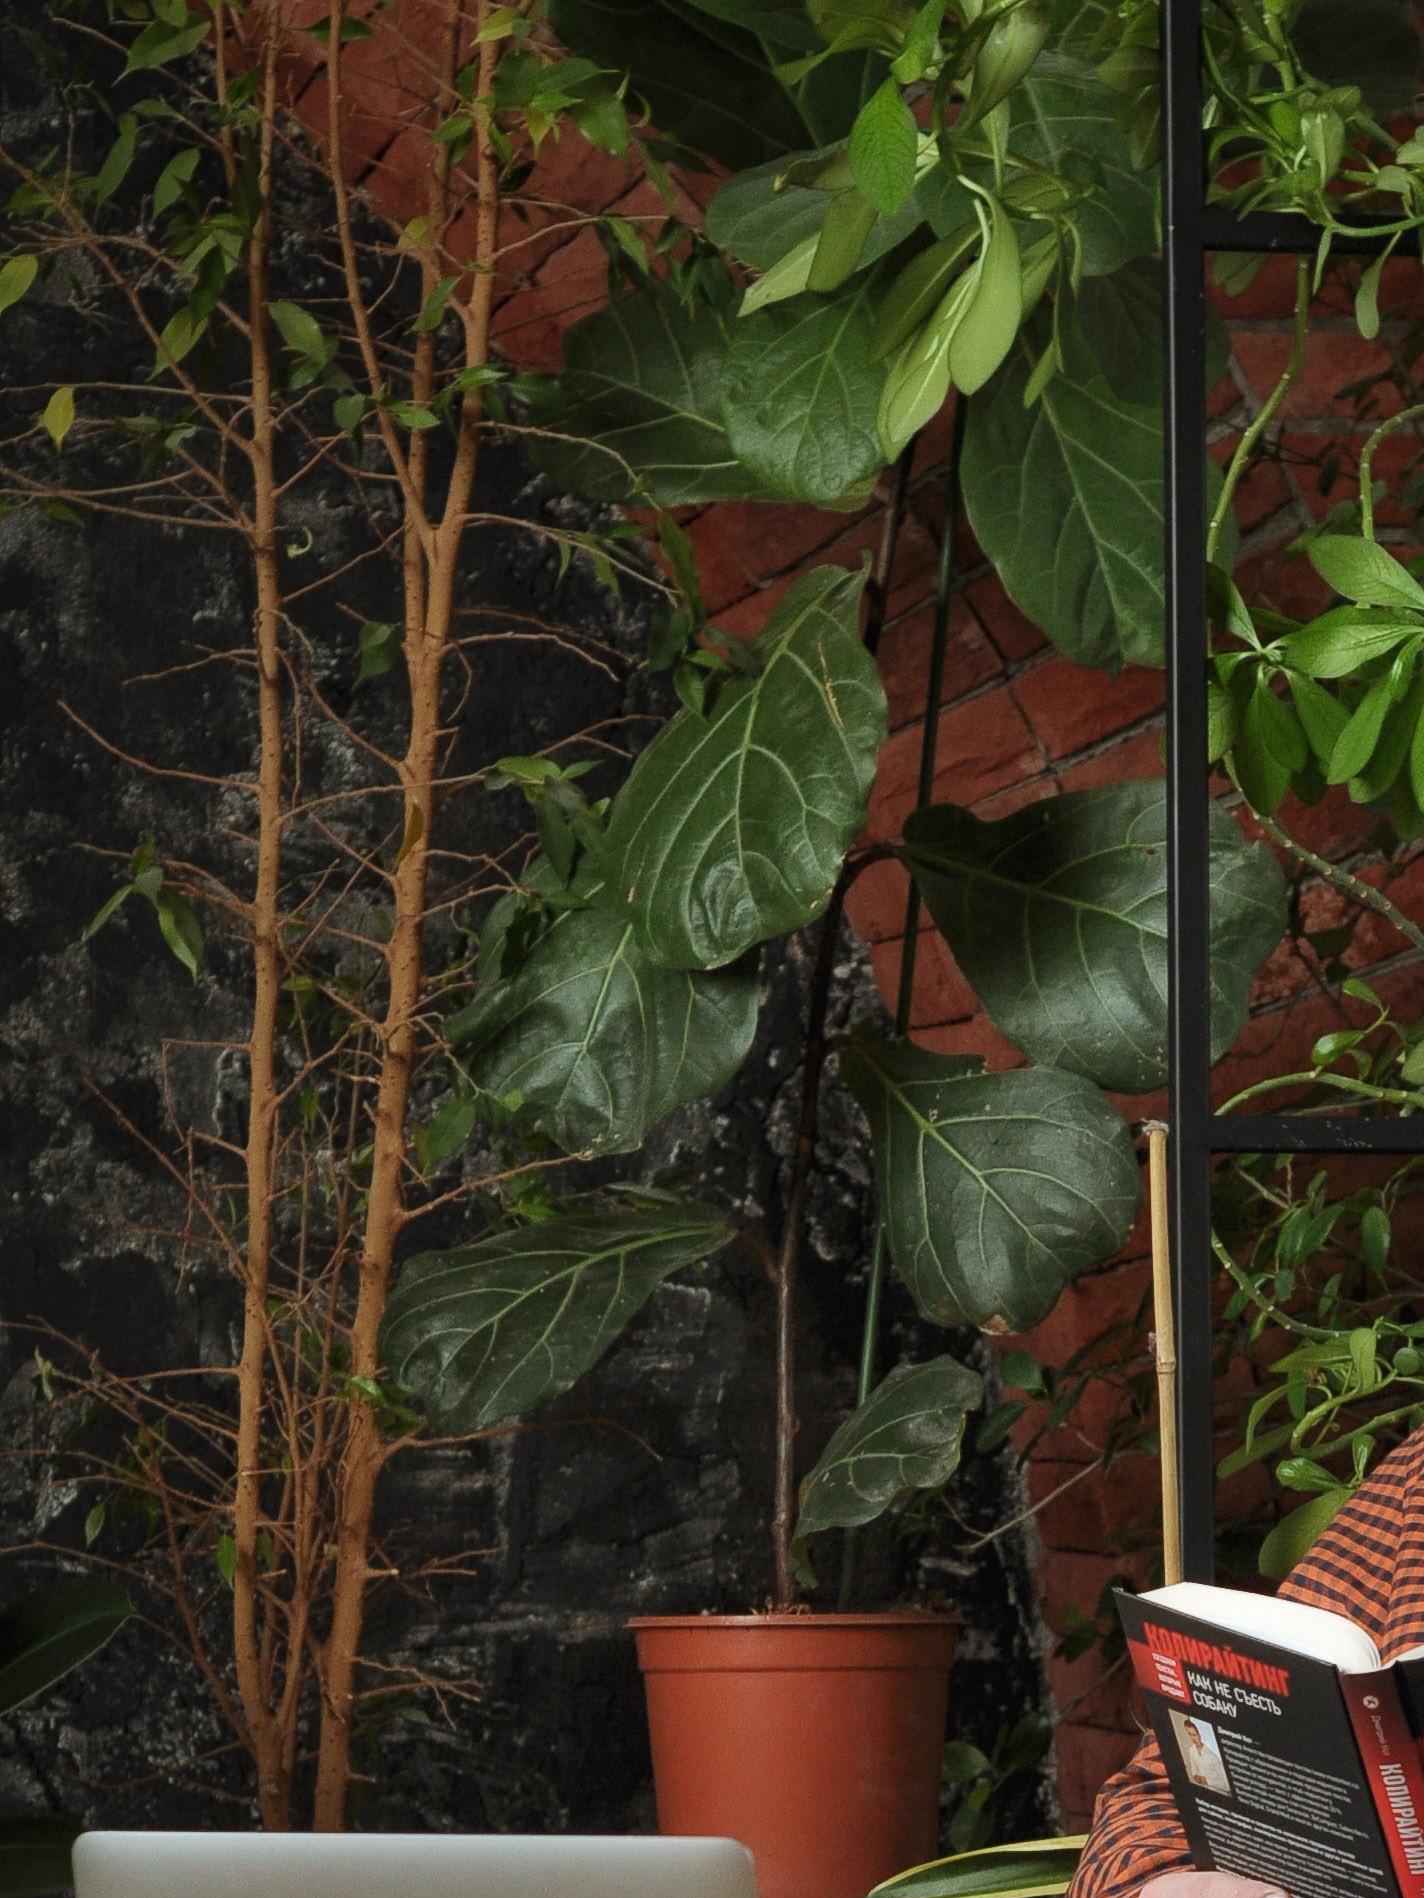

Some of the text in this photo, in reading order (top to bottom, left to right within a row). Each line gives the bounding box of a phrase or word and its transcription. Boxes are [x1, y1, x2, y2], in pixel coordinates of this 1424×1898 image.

[1143, 1621, 1290, 1697] КОПИРАЙТИНГ
[1187, 1670, 1213, 1692] КАК
[1215, 1680, 1232, 1699] НЕ
[1234, 1687, 1282, 1716] СЪЕСТЬ
[1193, 1690, 1238, 1719] СОБАКУ
